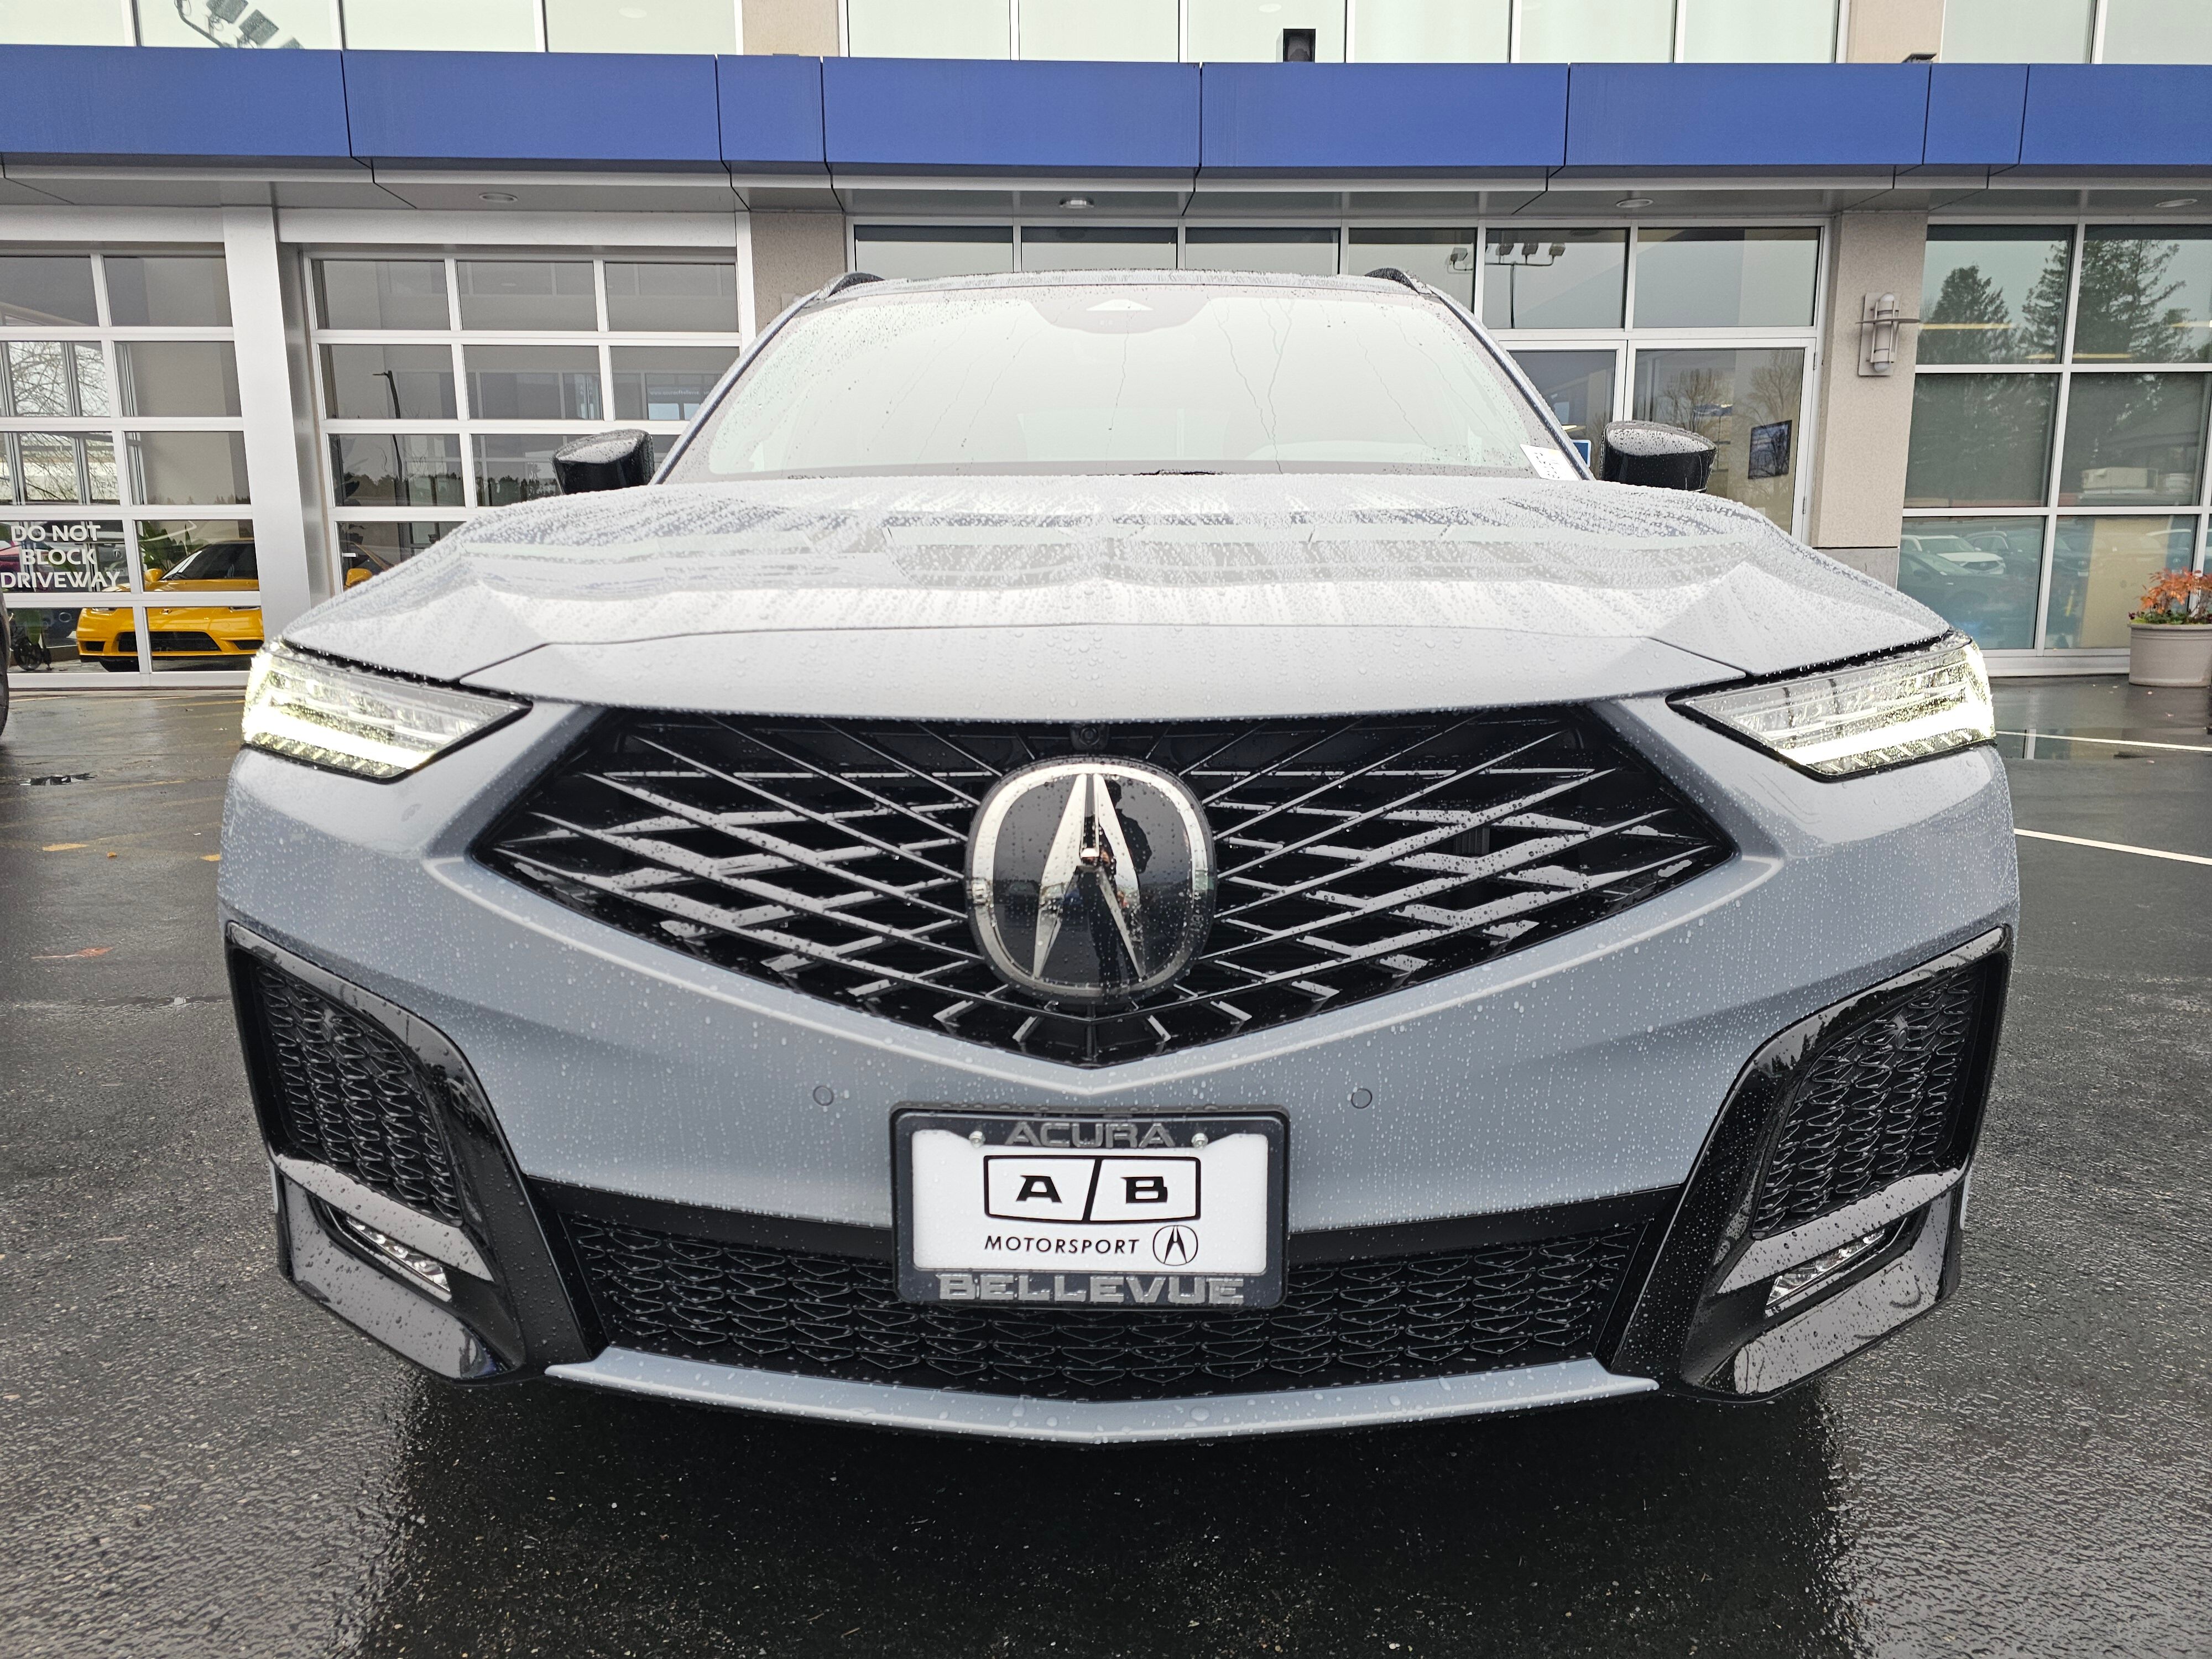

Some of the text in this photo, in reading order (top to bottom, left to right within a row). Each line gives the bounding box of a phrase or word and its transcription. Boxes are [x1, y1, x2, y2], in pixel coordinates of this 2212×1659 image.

[11, 525, 101, 541] DO NOT
[22, 549, 96, 565] BLOCK
[0, 572, 121, 588] DRIVEWAY
[1004, 1121, 1175, 1149] ACURA
[984, 1235, 1139, 1254] MOTORSPORT
[936, 1273, 1244, 1306] BELLEVUE
